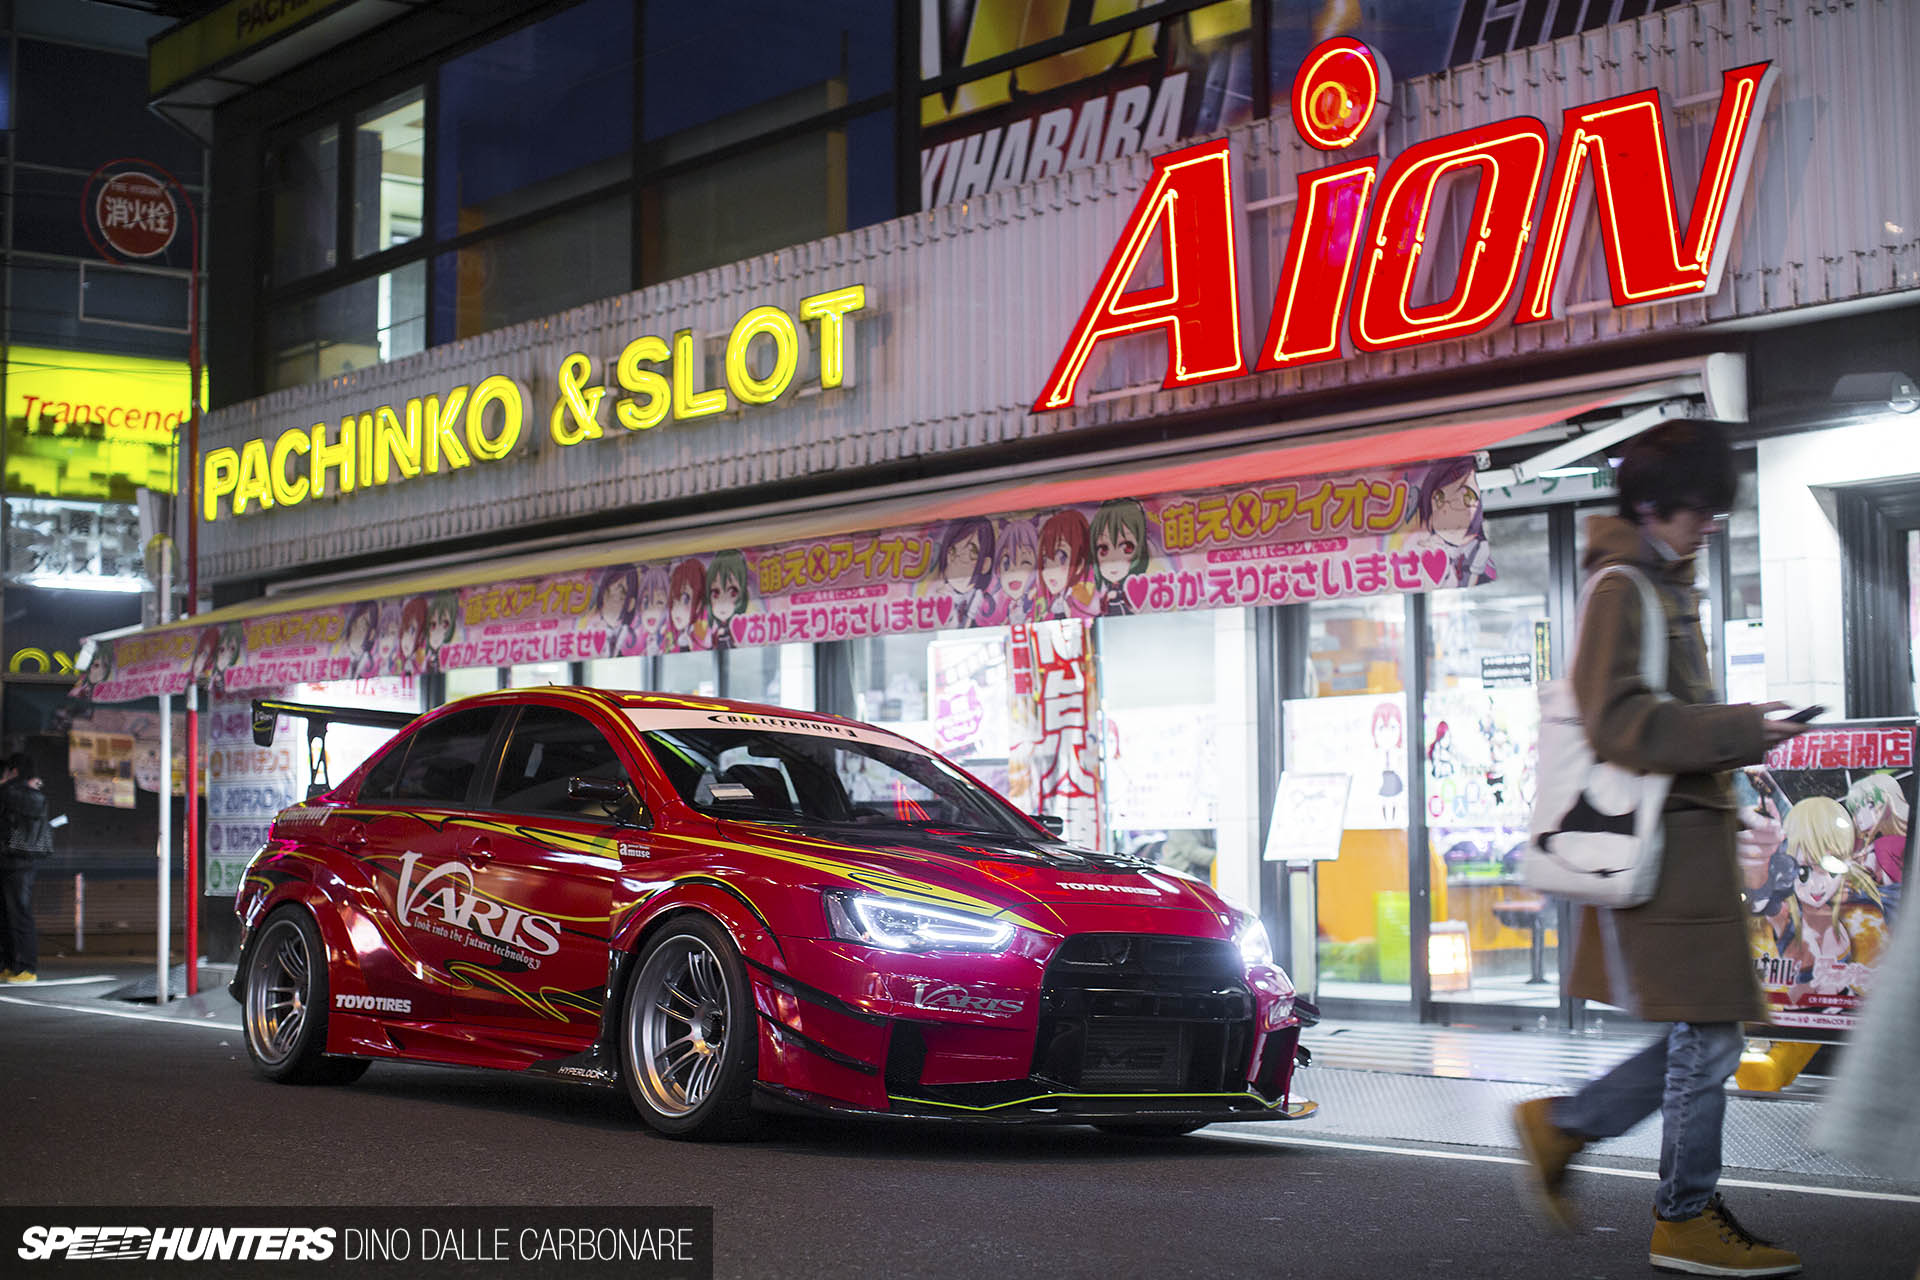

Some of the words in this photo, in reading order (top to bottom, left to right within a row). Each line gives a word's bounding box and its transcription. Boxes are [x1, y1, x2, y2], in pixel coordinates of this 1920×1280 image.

[105, 196, 170, 233] 消火栓
[22, 395, 184, 434] Transcend
[205, 375, 524, 521] PACHINKO
[551, 353, 606, 446] &
[616, 284, 866, 431] SLOT
[727, 715, 843, 734] BULLETPROOF
[1789, 730, 1910, 769] 新装開店
[620, 844, 650, 858] amuse
[397, 850, 561, 956] VARIS
[413, 916, 431, 932] look
[432, 922, 449, 939] into
[449, 928, 463, 942] the
[463, 933, 492, 951] future
[493, 943, 541, 970] technology
[912, 982, 1025, 1012] VARIS
